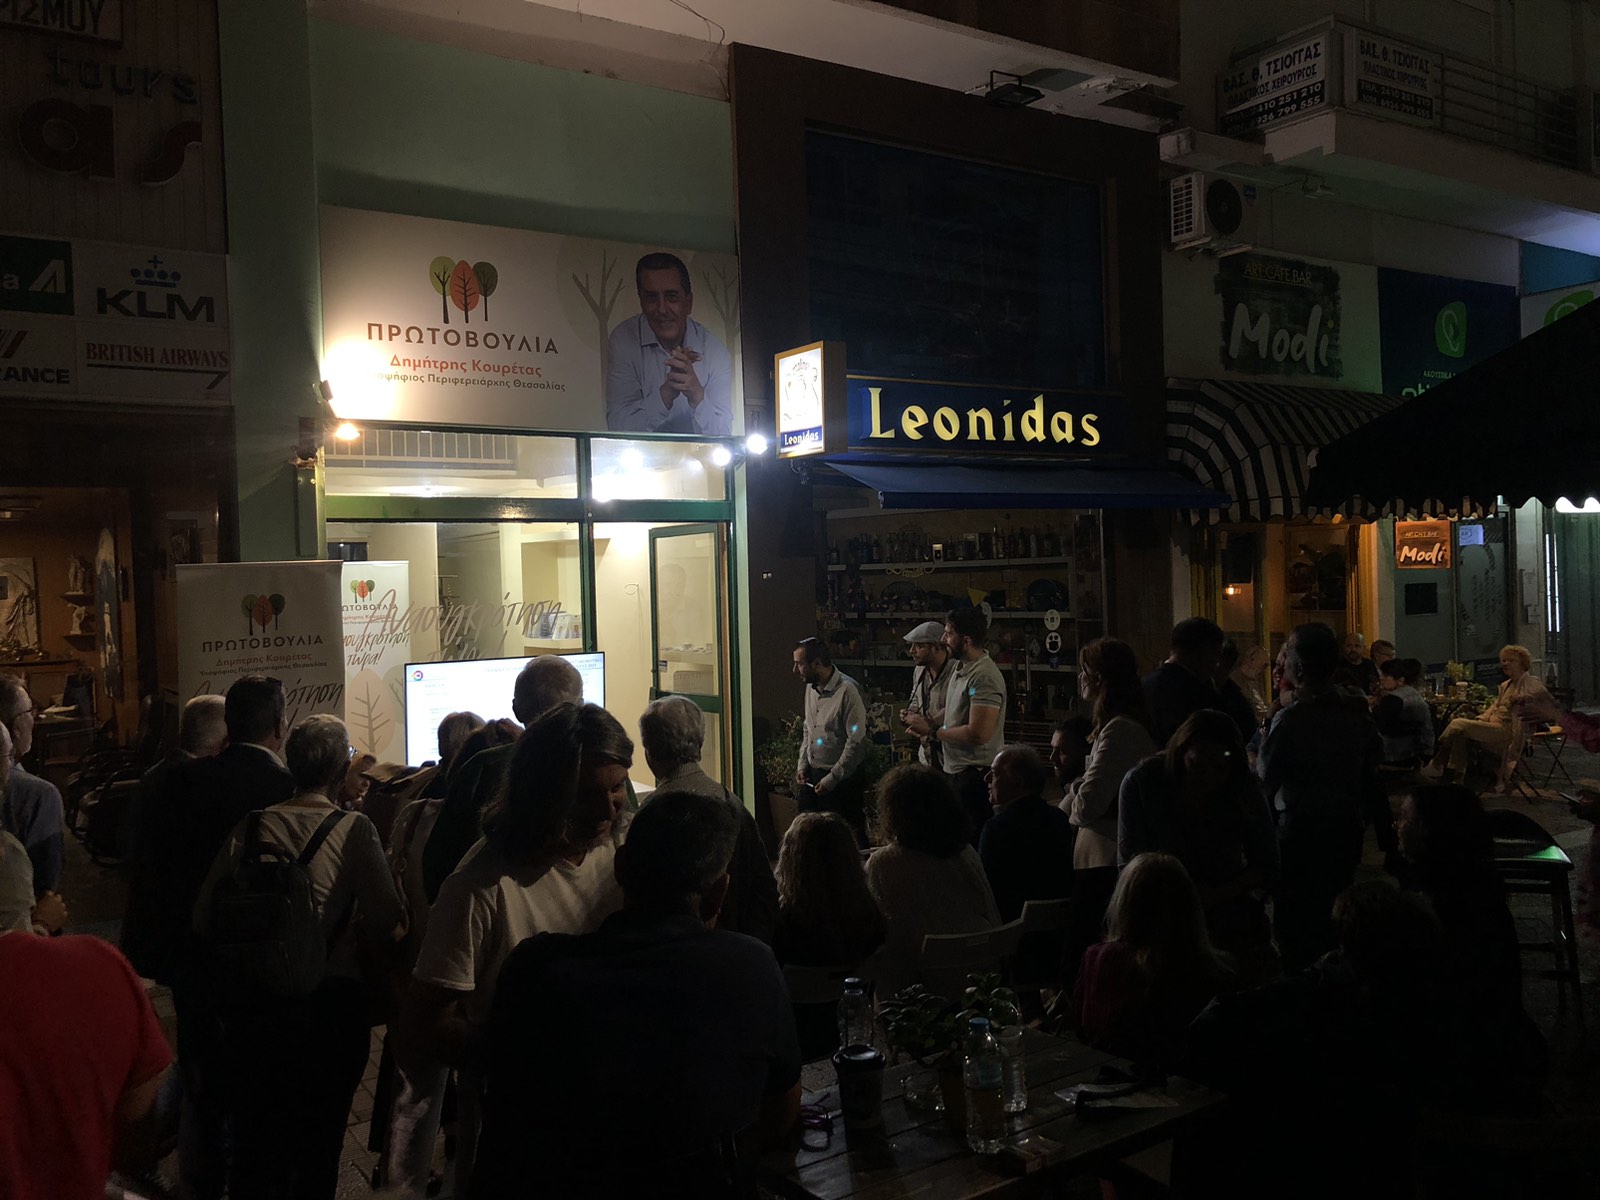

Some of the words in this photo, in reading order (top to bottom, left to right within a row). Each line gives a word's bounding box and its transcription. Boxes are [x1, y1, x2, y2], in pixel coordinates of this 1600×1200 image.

[0, 0, 104, 33] ΙΣΜΟΥ
[1265, 42, 1322, 76] ΤΣΙΟΓΓΑΣ
[46, 46, 198, 104] tours
[1271, 64, 1318, 90] ΧΕΙΡΟΥΡΓΟΣ
[1277, 102, 1298, 118] 799
[1300, 95, 1321, 110] 555
[1278, 92, 1298, 107] 251
[1300, 83, 1323, 98] 210
[97, 287, 215, 323] KLM
[367, 322, 559, 354] ΠΡΩΤΟΒΟΥΛΙΑ
[1228, 302, 1335, 373] Modi
[86, 342, 155, 364] BRITISH
[160, 348, 229, 368] AIRWAYS
[390, 354, 467, 373] Δημήτρης
[472, 359, 542, 377] Κουρέτας
[0, 366, 71, 385] ANCE
[428, 373, 510, 389] Περιφερειάρχης
[513, 378, 566, 392] Θεσσαλίας
[867, 387, 1101, 447] Leonidas
[784, 430, 820, 447] Leonidas
[1400, 543, 1446, 565] Modi
[202, 635, 323, 653] ΠΡΩΤΟΒΟΥΛΙΑ
[347, 646, 386, 671] τώρα!
